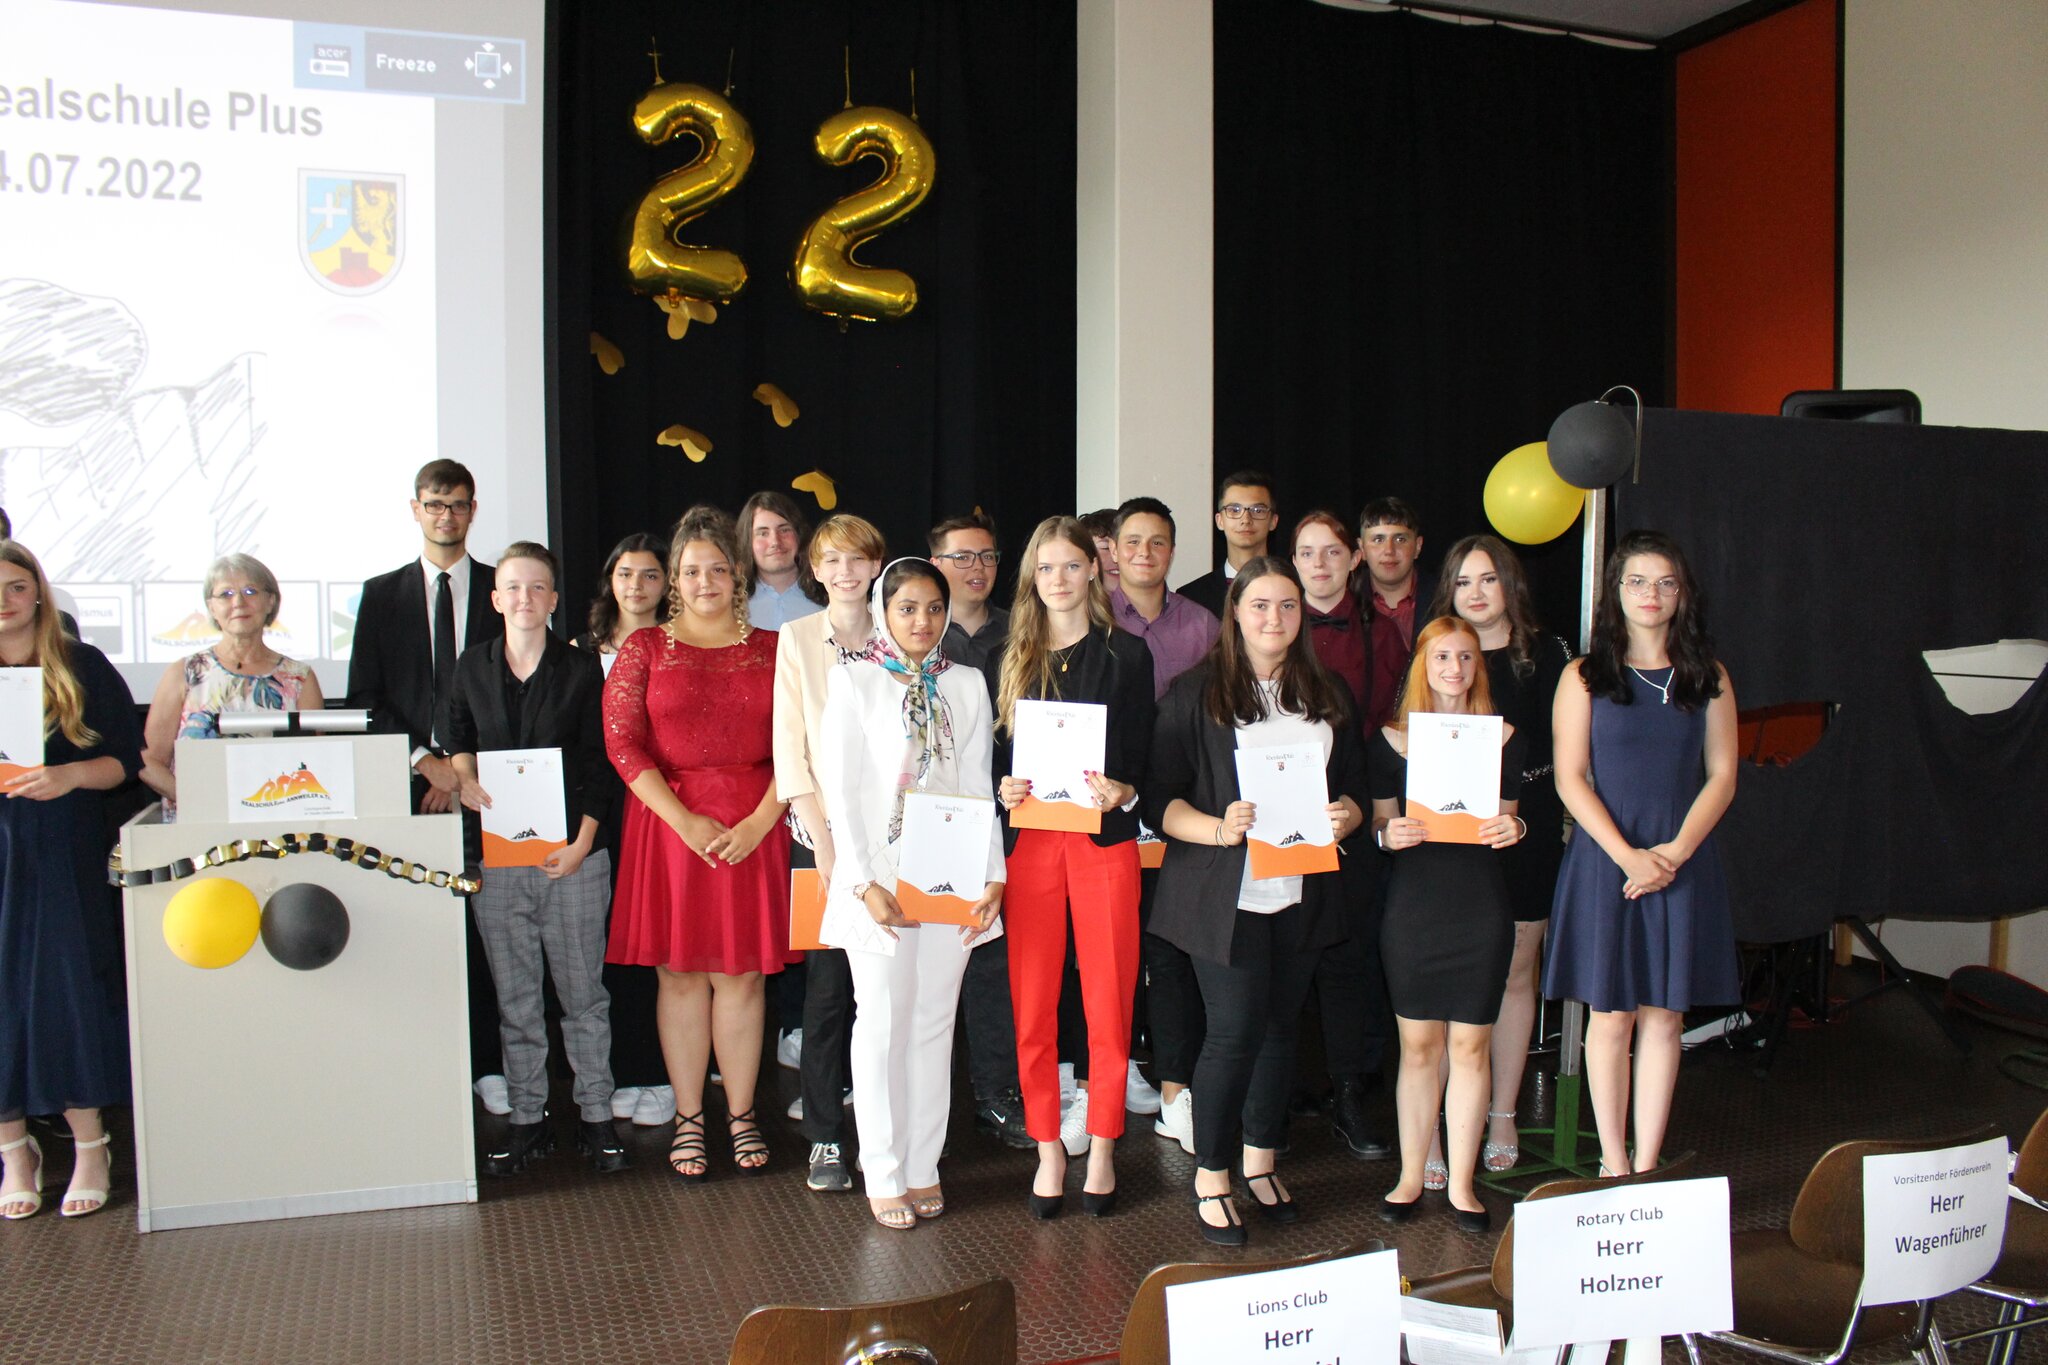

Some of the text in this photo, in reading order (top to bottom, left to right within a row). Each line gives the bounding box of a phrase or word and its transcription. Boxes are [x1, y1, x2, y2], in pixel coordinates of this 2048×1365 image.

[317, 46, 348, 58] acer
[375, 53, 437, 73] Freeze
[228, 90, 324, 137] Plus
[1893, 1162, 1992, 1185] Vorsitzender Förderverein
[1930, 1194, 1965, 1214] Herr
[1576, 1206, 1664, 1228] Rotary Club
[1597, 1239, 1644, 1257] Herr
[1895, 1223, 1987, 1255] Wagenführer
[1580, 1273, 1664, 1295] Holzner
[1247, 1290, 1329, 1316] Lions Club
[1264, 1327, 1314, 1350] Herr
